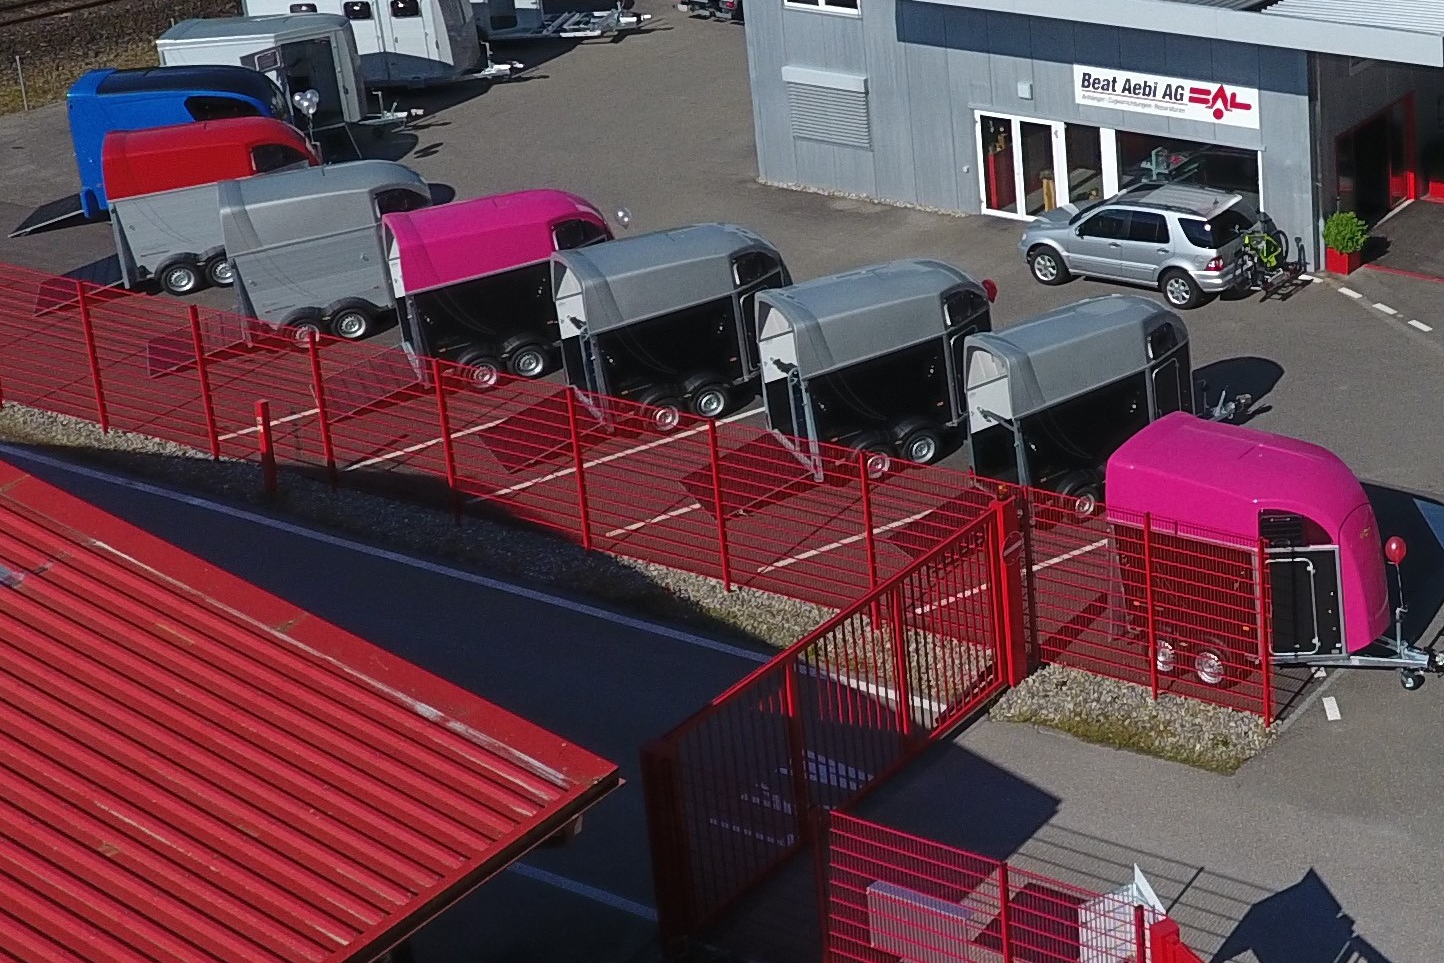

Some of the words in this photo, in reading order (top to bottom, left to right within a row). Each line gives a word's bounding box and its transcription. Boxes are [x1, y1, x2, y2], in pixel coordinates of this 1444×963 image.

[1081, 72, 1117, 93] Beat
[1121, 78, 1158, 98] Aebi
[1162, 83, 1185, 102] AG
